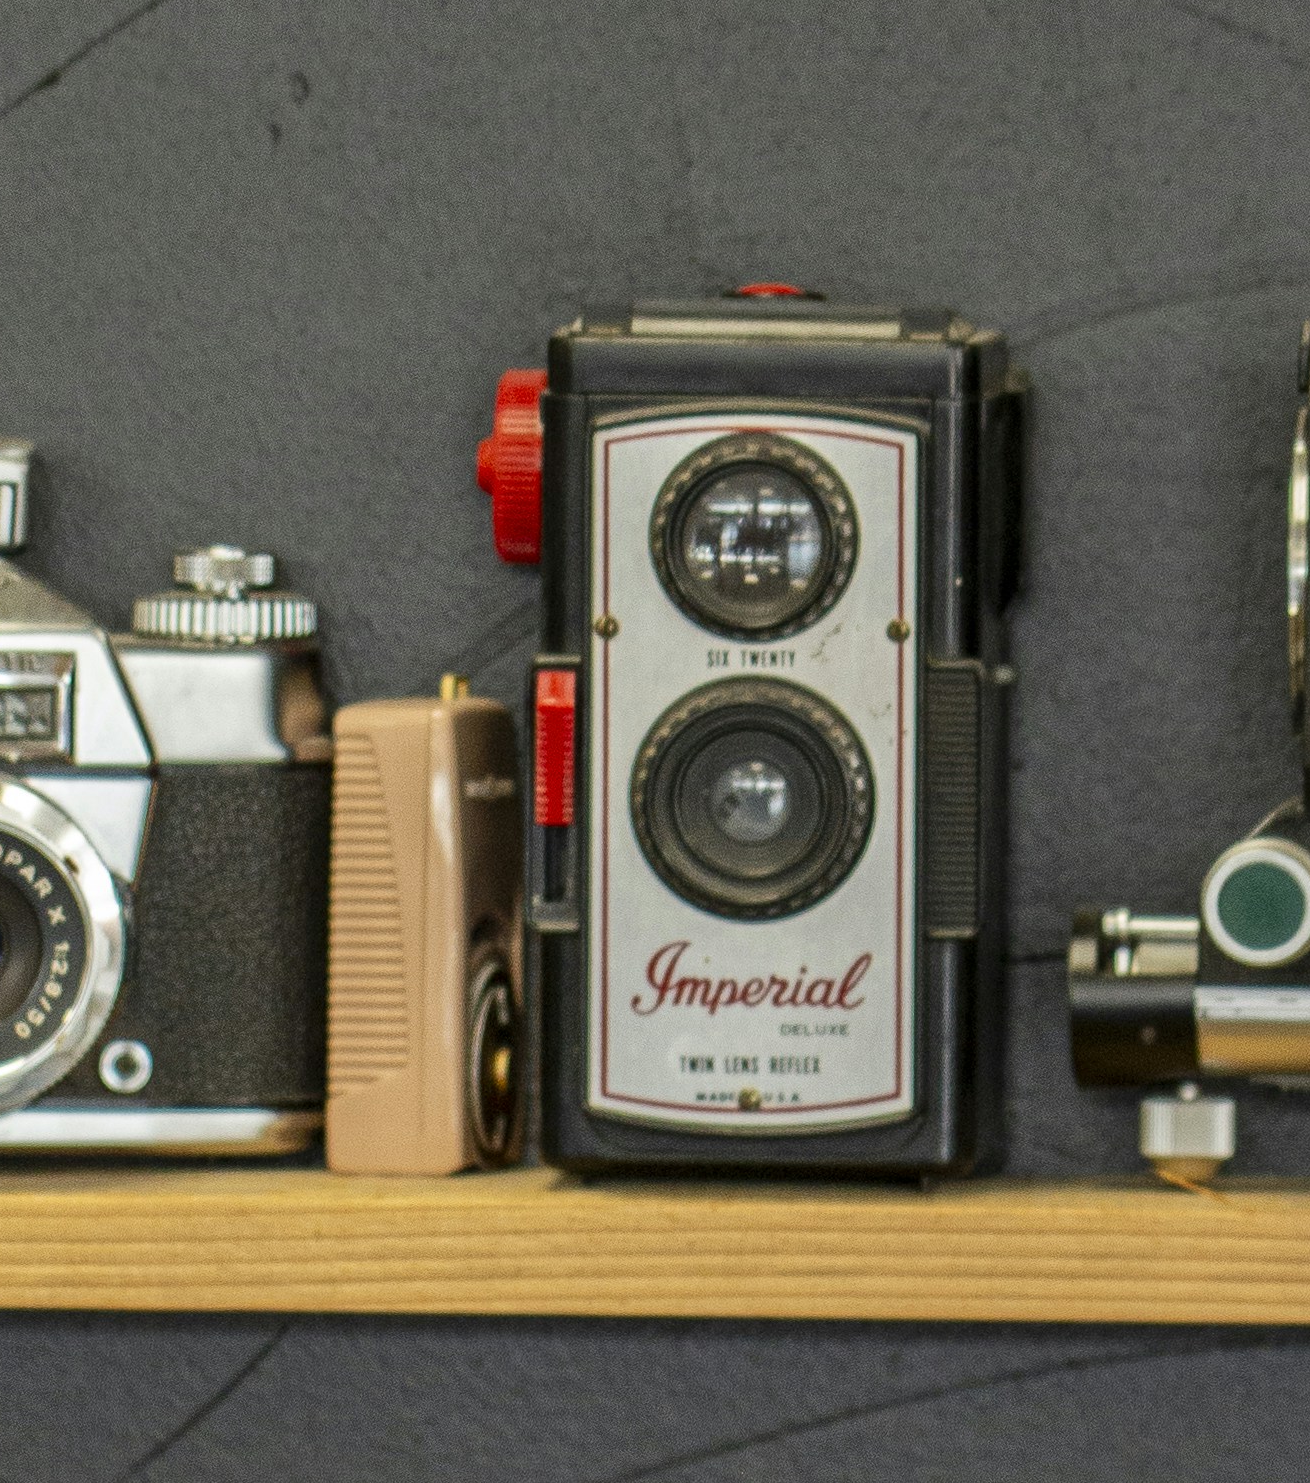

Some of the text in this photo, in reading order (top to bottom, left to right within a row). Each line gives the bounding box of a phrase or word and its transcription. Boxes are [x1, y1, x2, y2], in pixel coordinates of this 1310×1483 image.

[707, 649, 795, 668] SIX TWENTY
[47, 905, 67, 926] X
[630, 940, 873, 1016] Imperial
[778, 1023, 849, 1036] DELUXE
[680, 1055, 820, 1074] TWIN LENS REFLEX
